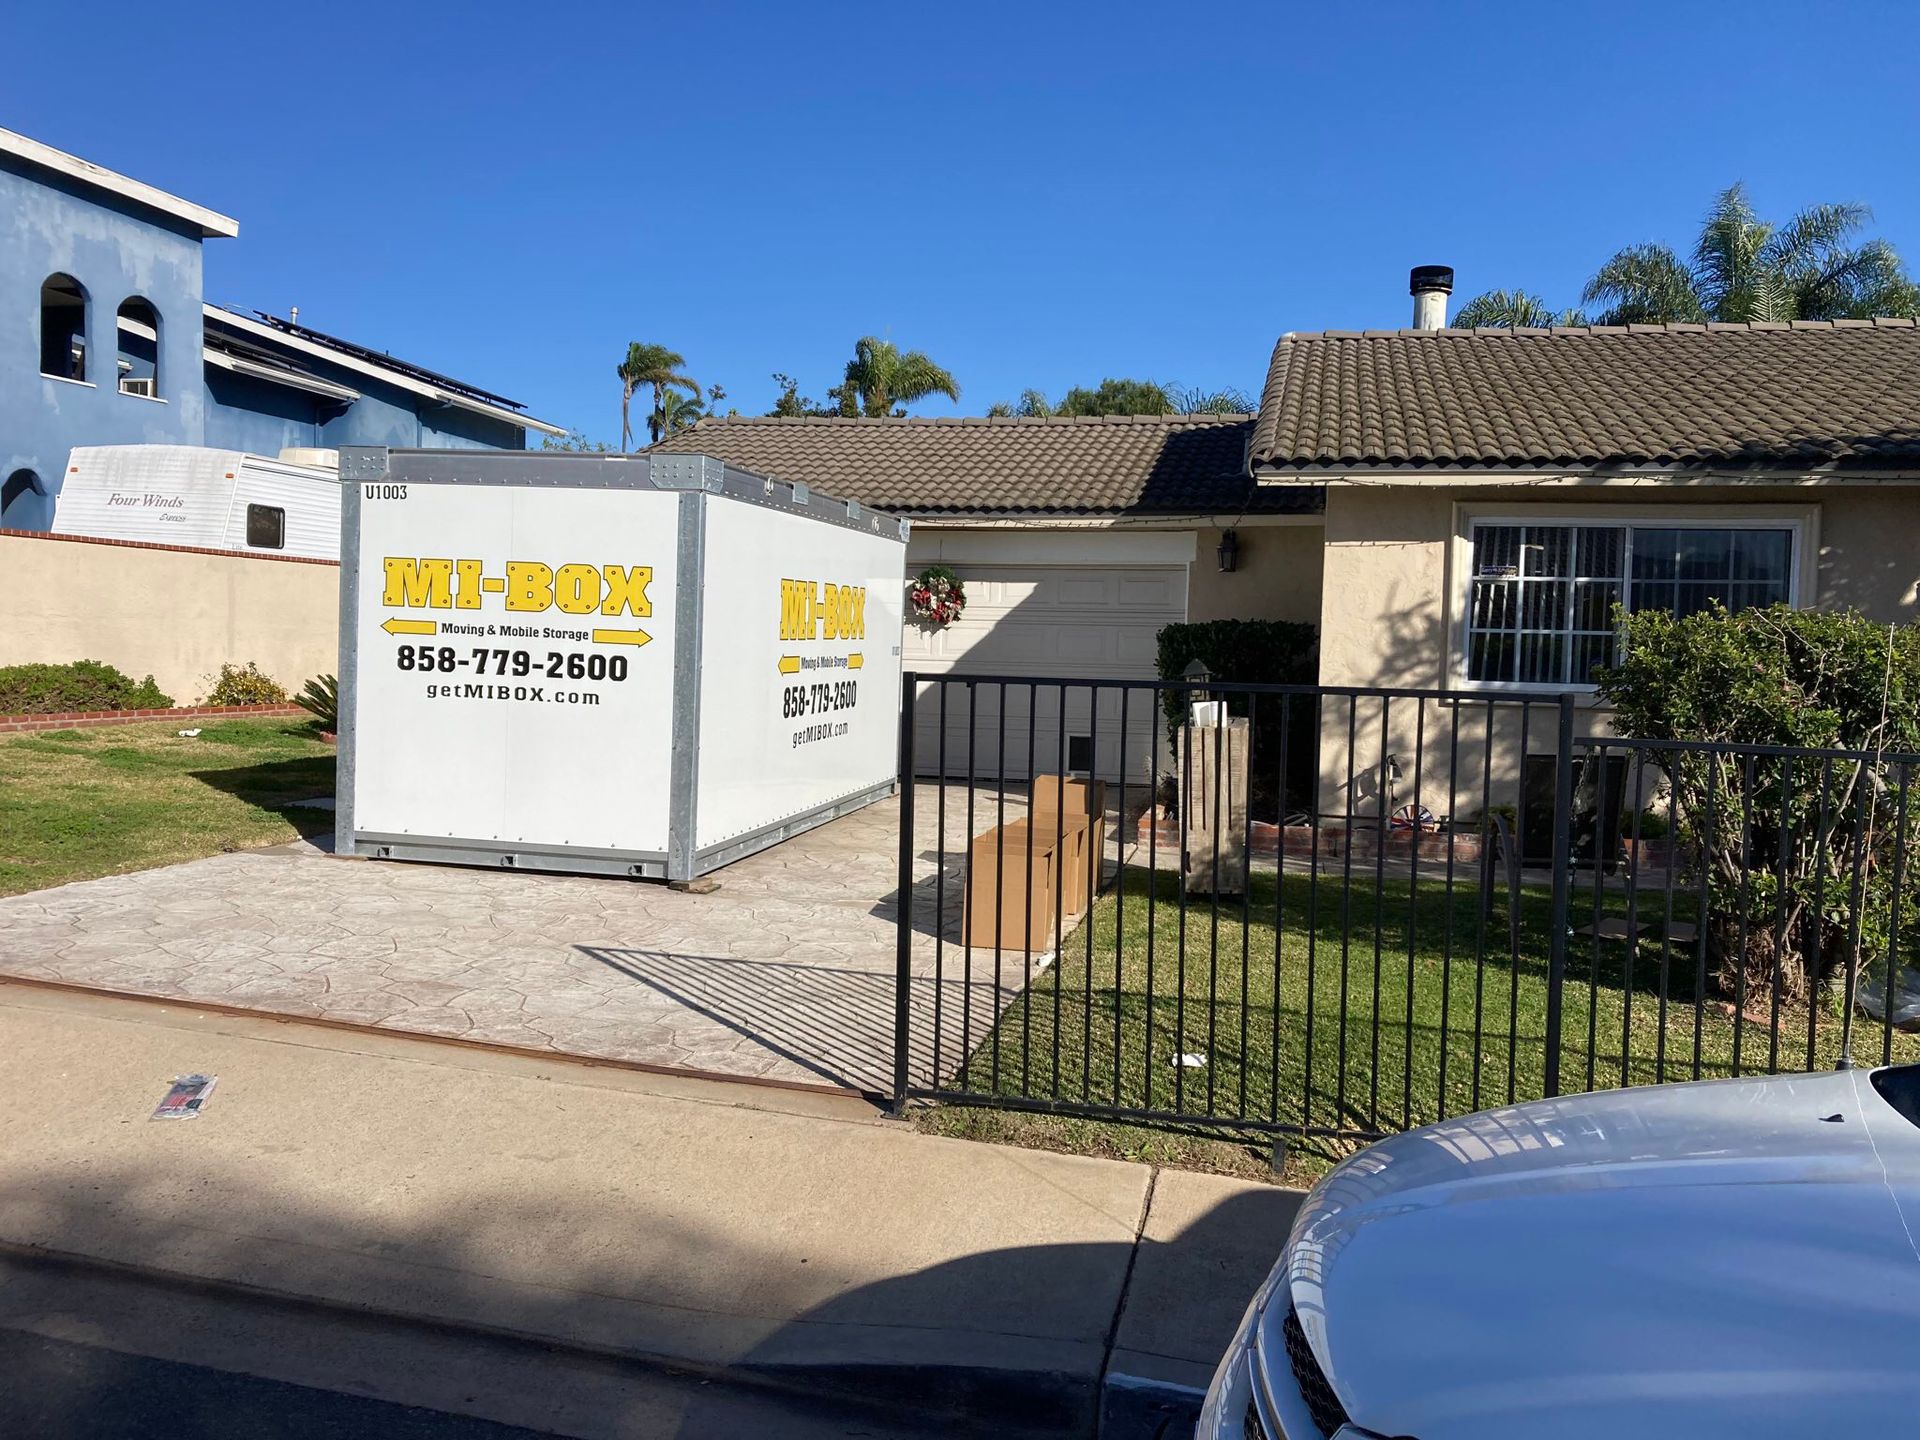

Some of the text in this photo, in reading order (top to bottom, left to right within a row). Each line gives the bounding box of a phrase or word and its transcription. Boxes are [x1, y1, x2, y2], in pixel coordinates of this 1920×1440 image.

[107, 493, 185, 508] Four Winds
[366, 485, 407, 500] U1003
[382, 556, 653, 618] MI-BOX
[779, 577, 866, 641] MI-BOX
[441, 623, 589, 641] Moving & Mobile Storage
[396, 644, 628, 682] 858-779-2600
[801, 656, 816, 671] Moving
[426, 683, 600, 706] getMIBOX.com
[783, 680, 857, 719] 858-779-2600
[792, 721, 848, 748] getMIBOX.com
